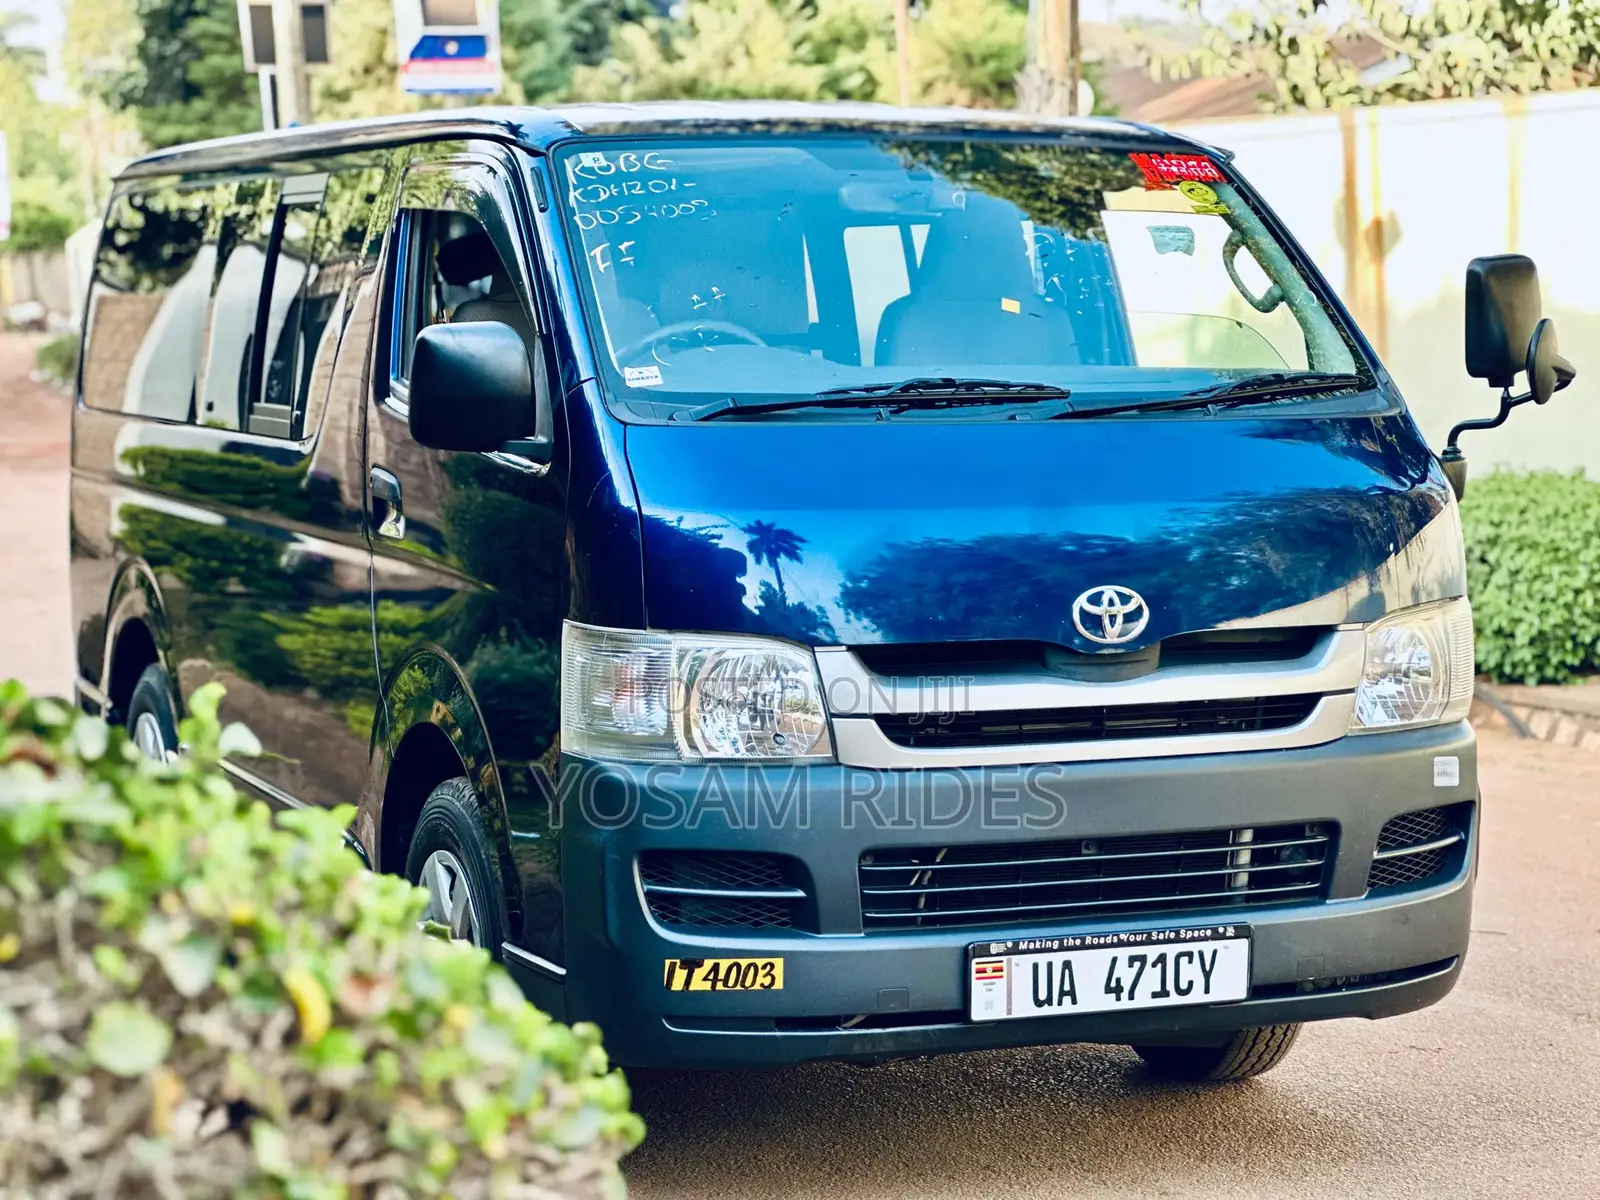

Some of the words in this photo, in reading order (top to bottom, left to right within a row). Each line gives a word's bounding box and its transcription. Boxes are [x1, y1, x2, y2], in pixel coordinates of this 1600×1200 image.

[1018, 939, 1060, 950] Making
[1063, 937, 1082, 947] the
[1085, 934, 1118, 945] Roads
[1122, 932, 1147, 943] Your
[1151, 930, 1176, 941] Safe
[1179, 928, 1213, 940] Space
[1031, 959, 1079, 1009] UA
[1103, 948, 1219, 1002] 471CY
